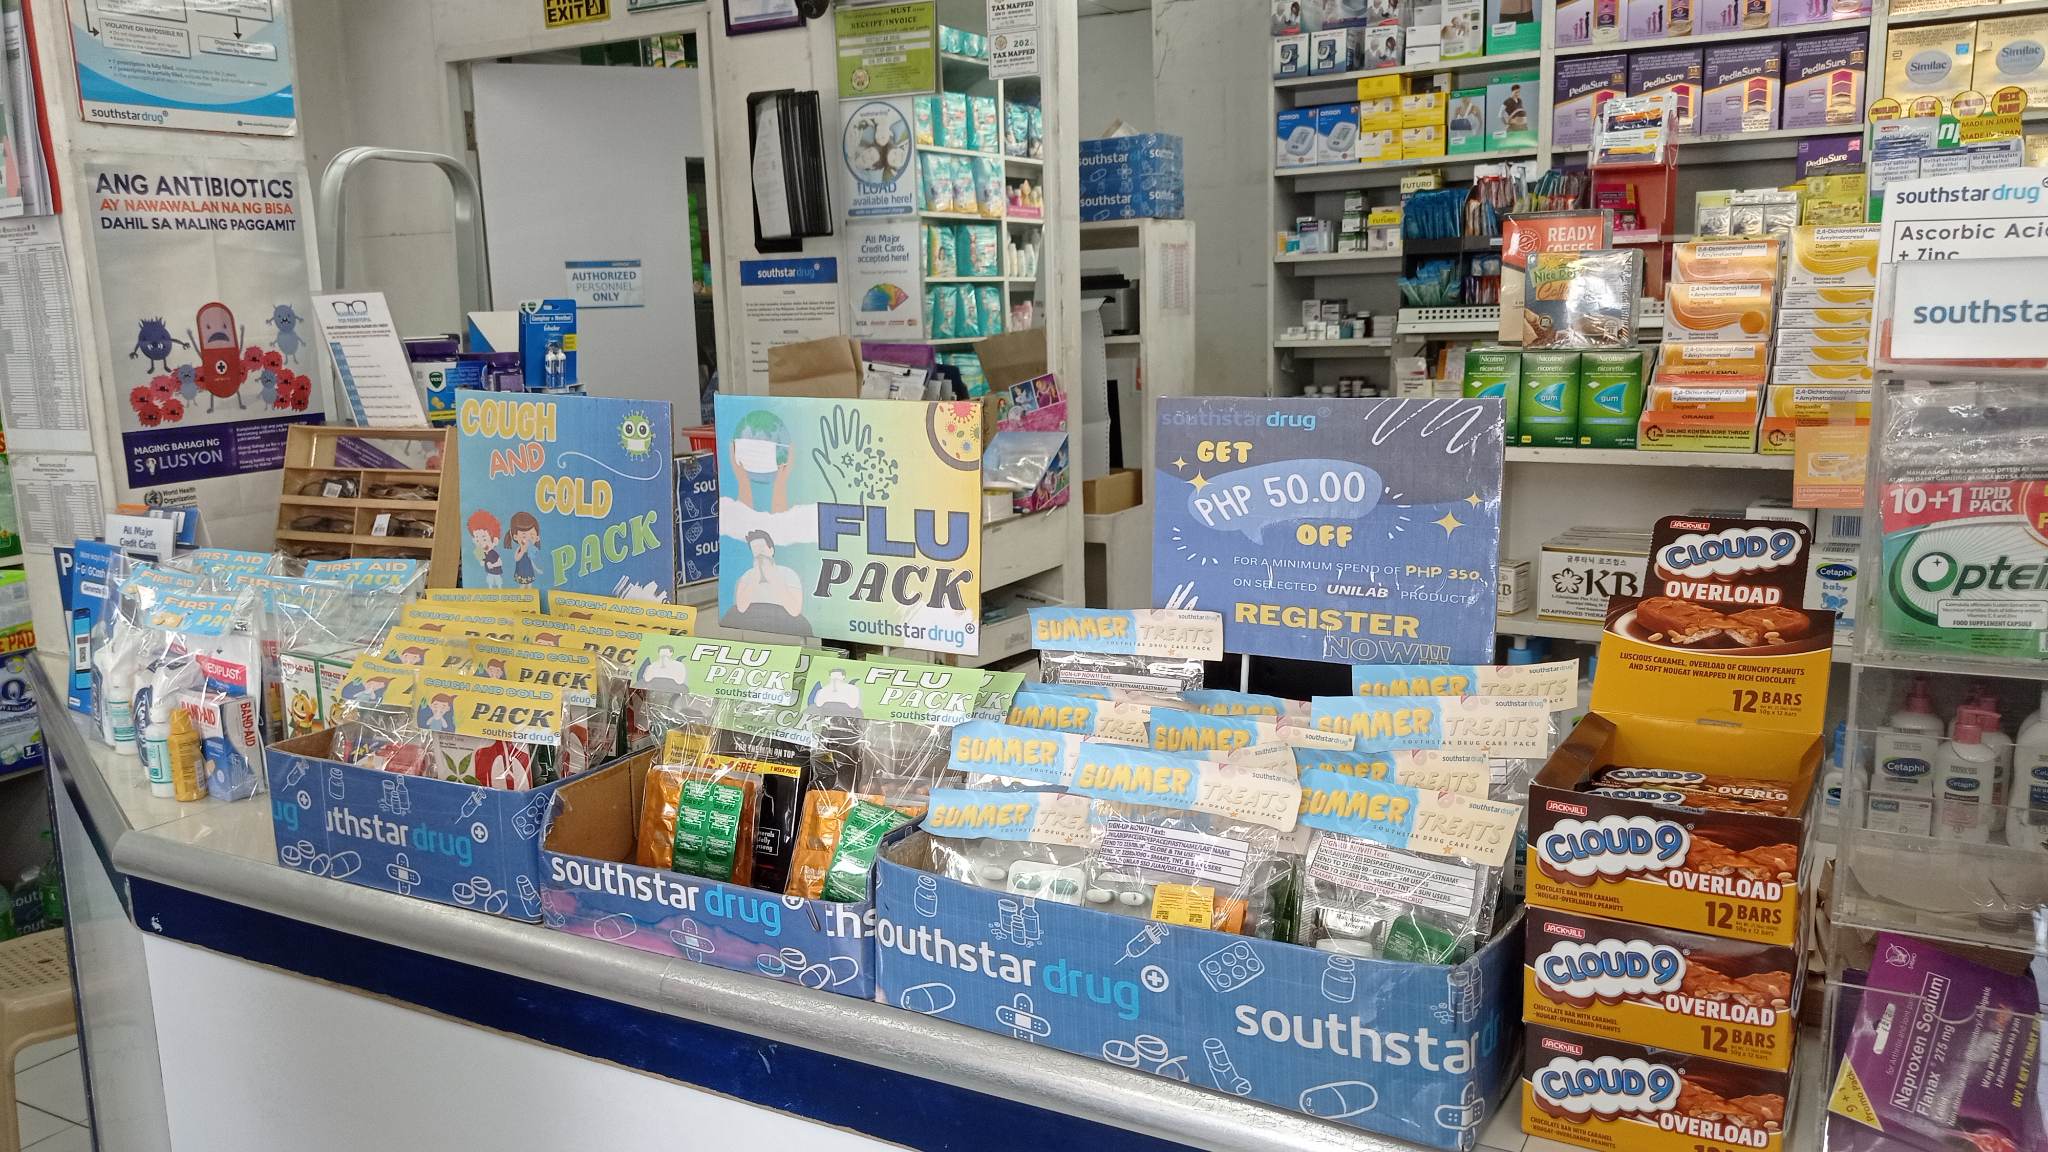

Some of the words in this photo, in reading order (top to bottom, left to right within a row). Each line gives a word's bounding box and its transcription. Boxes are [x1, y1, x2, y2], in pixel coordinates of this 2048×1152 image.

[548, 5, 581, 23] EXIT
[993, 51, 1007, 60] TAX
[1008, 49, 1035, 58] MAPPED
[2002, 46, 2041, 57] Similac
[1719, 66, 1762, 84] PediaSure
[1801, 58, 1847, 78] PediaSure
[1910, 62, 1947, 72] Similac
[1569, 79, 1609, 97] PediaSure
[1643, 73, 1684, 91] PediaSure
[1806, 154, 1847, 174] PediaSure
[96, 173, 148, 195] ANG
[155, 176, 294, 199] ANTIBIOTICS
[1402, 180, 1432, 190] FUTURO
[100, 199, 120, 212] AY
[125, 199, 219, 214] NAWAWALAN
[221, 203, 240, 214] NA
[242, 203, 262, 214] NG
[265, 203, 293, 215] BISA
[101, 217, 148, 230] DAHIL
[152, 218, 172, 230] SA
[175, 218, 228, 231] MALING
[230, 219, 296, 232] PAGGAMIT
[1548, 226, 1596, 241] READY
[1900, 224, 1995, 240] Ascorbic
[865, 235, 876, 244] All
[878, 234, 900, 245] Major
[884, 243, 905, 253] Cards
[572, 271, 637, 281] AUTHORIZED
[576, 281, 632, 292] PERSONNEL
[593, 292, 619, 302] ONLY
[461, 399, 557, 442] COUGH
[134, 445, 170, 455] MAGING
[171, 439, 205, 451] BAHAGI
[206, 438, 220, 447] NG
[1197, 440, 1252, 463] GET
[490, 442, 545, 480] AND
[535, 475, 613, 519] COLD
[1194, 485, 1251, 526] PHP
[1264, 471, 1366, 507] 50.00
[1890, 487, 1962, 513] 10+1
[1970, 487, 2011, 499] TIPID
[1970, 500, 2013, 512] PACK
[123, 526, 134, 535] All
[135, 526, 154, 538] Major
[141, 538, 157, 549] Cards
[817, 502, 970, 562] FLU
[1297, 524, 1353, 548] OFF
[552, 511, 660, 586] PACK
[1666, 532, 1767, 569] CLOUD
[1769, 531, 1796, 560] 9
[315, 562, 364, 572] FIRST
[368, 562, 407, 571] AID
[1234, 556, 1258, 566] FOR
[1272, 559, 1332, 571] MINIMUM
[1336, 562, 1381, 574] SPEND
[1384, 566, 1400, 575] OF
[1405, 565, 1442, 578] PHP
[812, 558, 973, 611] PACK
[1233, 578, 1251, 587] ON
[1255, 580, 1317, 592] SELECTED
[1327, 584, 1389, 598] UNILAB
[1400, 591, 1478, 604] PRODUCTS
[1584, 569, 1638, 598] KB
[1666, 581, 1780, 605] OVERLOAD
[1822, 582, 1848, 592] baby
[556, 597, 607, 611] COUGH
[608, 604, 643, 614] AND
[646, 609, 688, 620] COLD
[1037, 616, 1129, 640] SUMMER
[1139, 625, 1214, 643] TREATS
[1234, 603, 1420, 638] REGISTER
[546, 652, 589, 664] COLD
[691, 644, 771, 667] FLU
[1324, 635, 1451, 664] NOW!!!
[1620, 652, 1651, 662] LUSCIOUS
[1690, 660, 1725, 670] OVERLOAD
[1738, 664, 1770, 673] CRUNCHY
[520, 667, 592, 690] PACK
[705, 665, 791, 690] PACK
[865, 667, 952, 688] FLU
[1664, 667, 1690, 676] NOUGAT
[1693, 670, 1726, 679] WRAPPED
[1755, 675, 1795, 684] CHOCOLATE
[424, 678, 470, 690] COUGH
[472, 685, 503, 695] AND
[506, 689, 553, 700] COLD
[879, 687, 972, 712] PACK
[1733, 689, 1758, 713] 12
[1762, 692, 1802, 706] BARS
[471, 702, 554, 728] PACK
[1446, 717, 1539, 738] TREATS
[957, 736, 1058, 766] SUMMER
[734, 762, 757, 773] FREE
[1887, 762, 1925, 773] Cetaphil
[1078, 763, 1193, 796] SUMMER
[1203, 782, 1291, 813] TREATS
[929, 802, 1031, 828] SUMMER
[1299, 789, 1410, 823] SUMMER
[1418, 810, 1507, 845] TREATS
[412, 830, 472, 867] drug
[1546, 825, 1653, 863] CLOUD
[1655, 824, 1682, 861] 9
[1535, 884, 1565, 895] CHOCOLATE
[1593, 893, 1620, 903] CARAMEL
[1669, 870, 1782, 900] OVERLOAD
[552, 856, 700, 911] southstar
[705, 886, 783, 938] drug
[1705, 901, 1732, 929] 12
[1737, 904, 1781, 924] BARS
[1544, 951, 1650, 985] CLOUD
[1652, 950, 1679, 985] 9
[1043, 965, 1140, 1020] drug
[1665, 995, 1776, 1026] OVERLOAD
[1235, 1002, 1478, 1073] southstar
[1891, 1034, 1930, 1109] Naproxen
[1917, 977, 1945, 1034] Sodium
[1917, 1072, 1942, 1118] Flanax
[1934, 1040, 1950, 1064] 275
